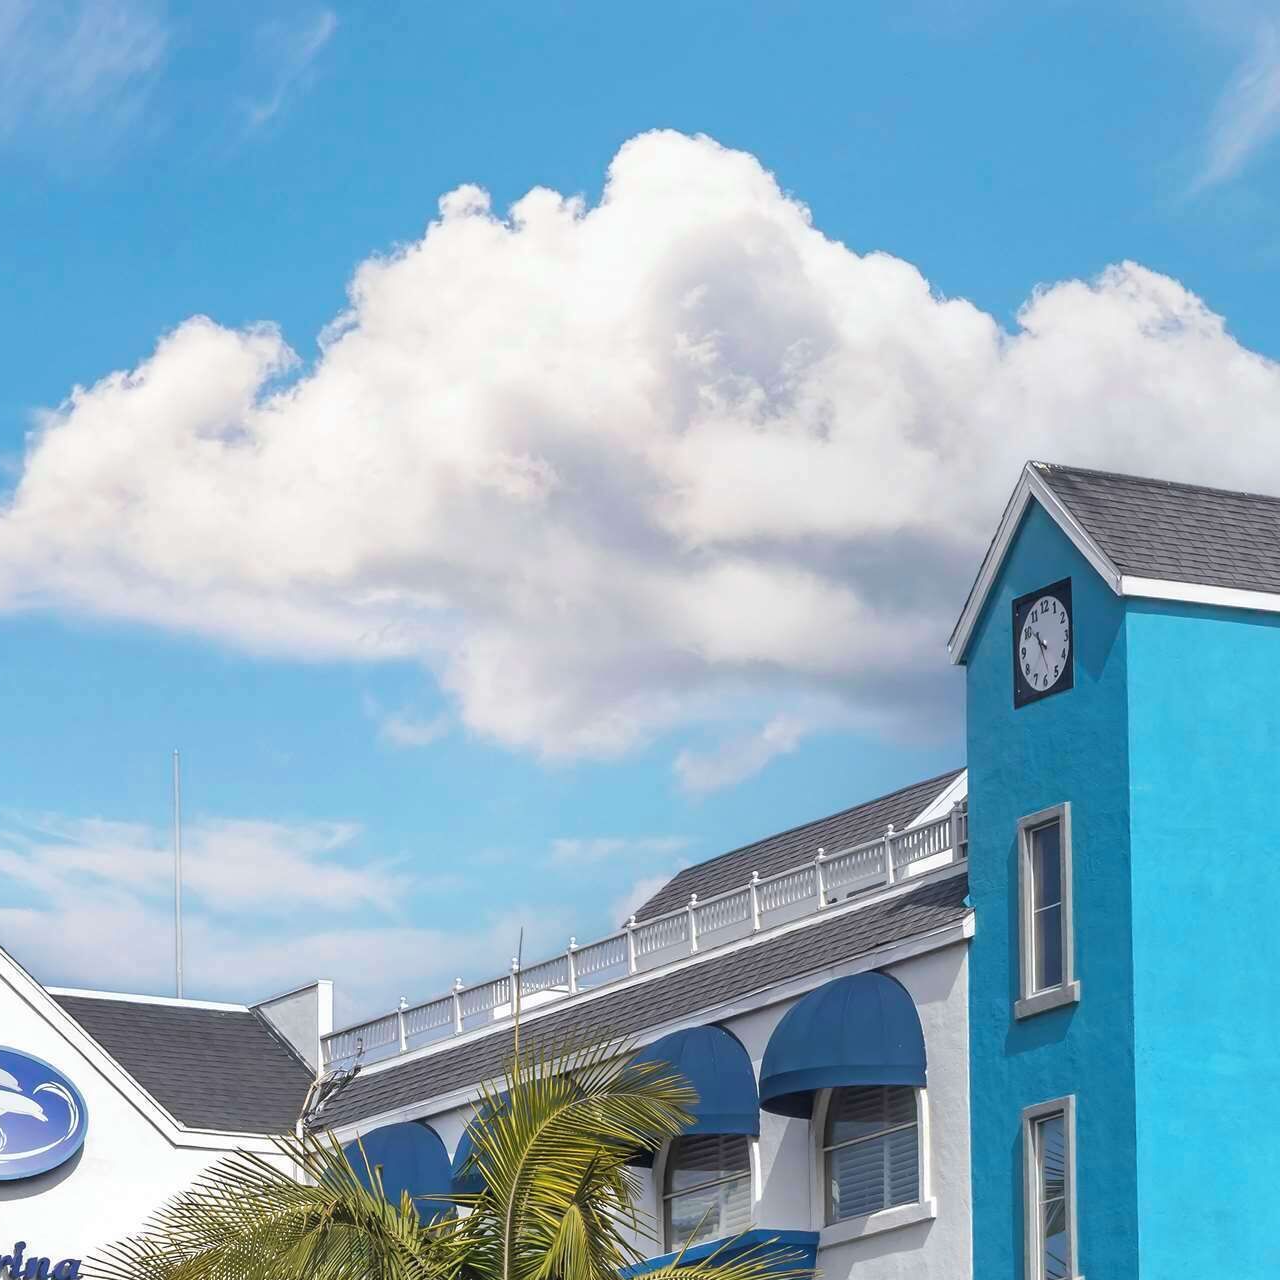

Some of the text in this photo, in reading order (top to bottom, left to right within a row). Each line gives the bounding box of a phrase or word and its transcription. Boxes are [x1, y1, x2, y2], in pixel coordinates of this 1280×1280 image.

[1040, 599, 1049, 614] 12
[1052, 601, 1057, 614] 1
[1031, 610, 1038, 623] 11
[1060, 611, 1066, 624] 2
[1024, 626, 1032, 640] 10
[1063, 630, 1069, 642] 3
[1021, 647, 1027, 660] 9
[1061, 648, 1066, 660] 4
[1025, 663, 1031, 676] 8
[1054, 665, 1059, 678] 5
[1033, 673, 1038, 686] 7
[1043, 674, 1048, 687] 6
